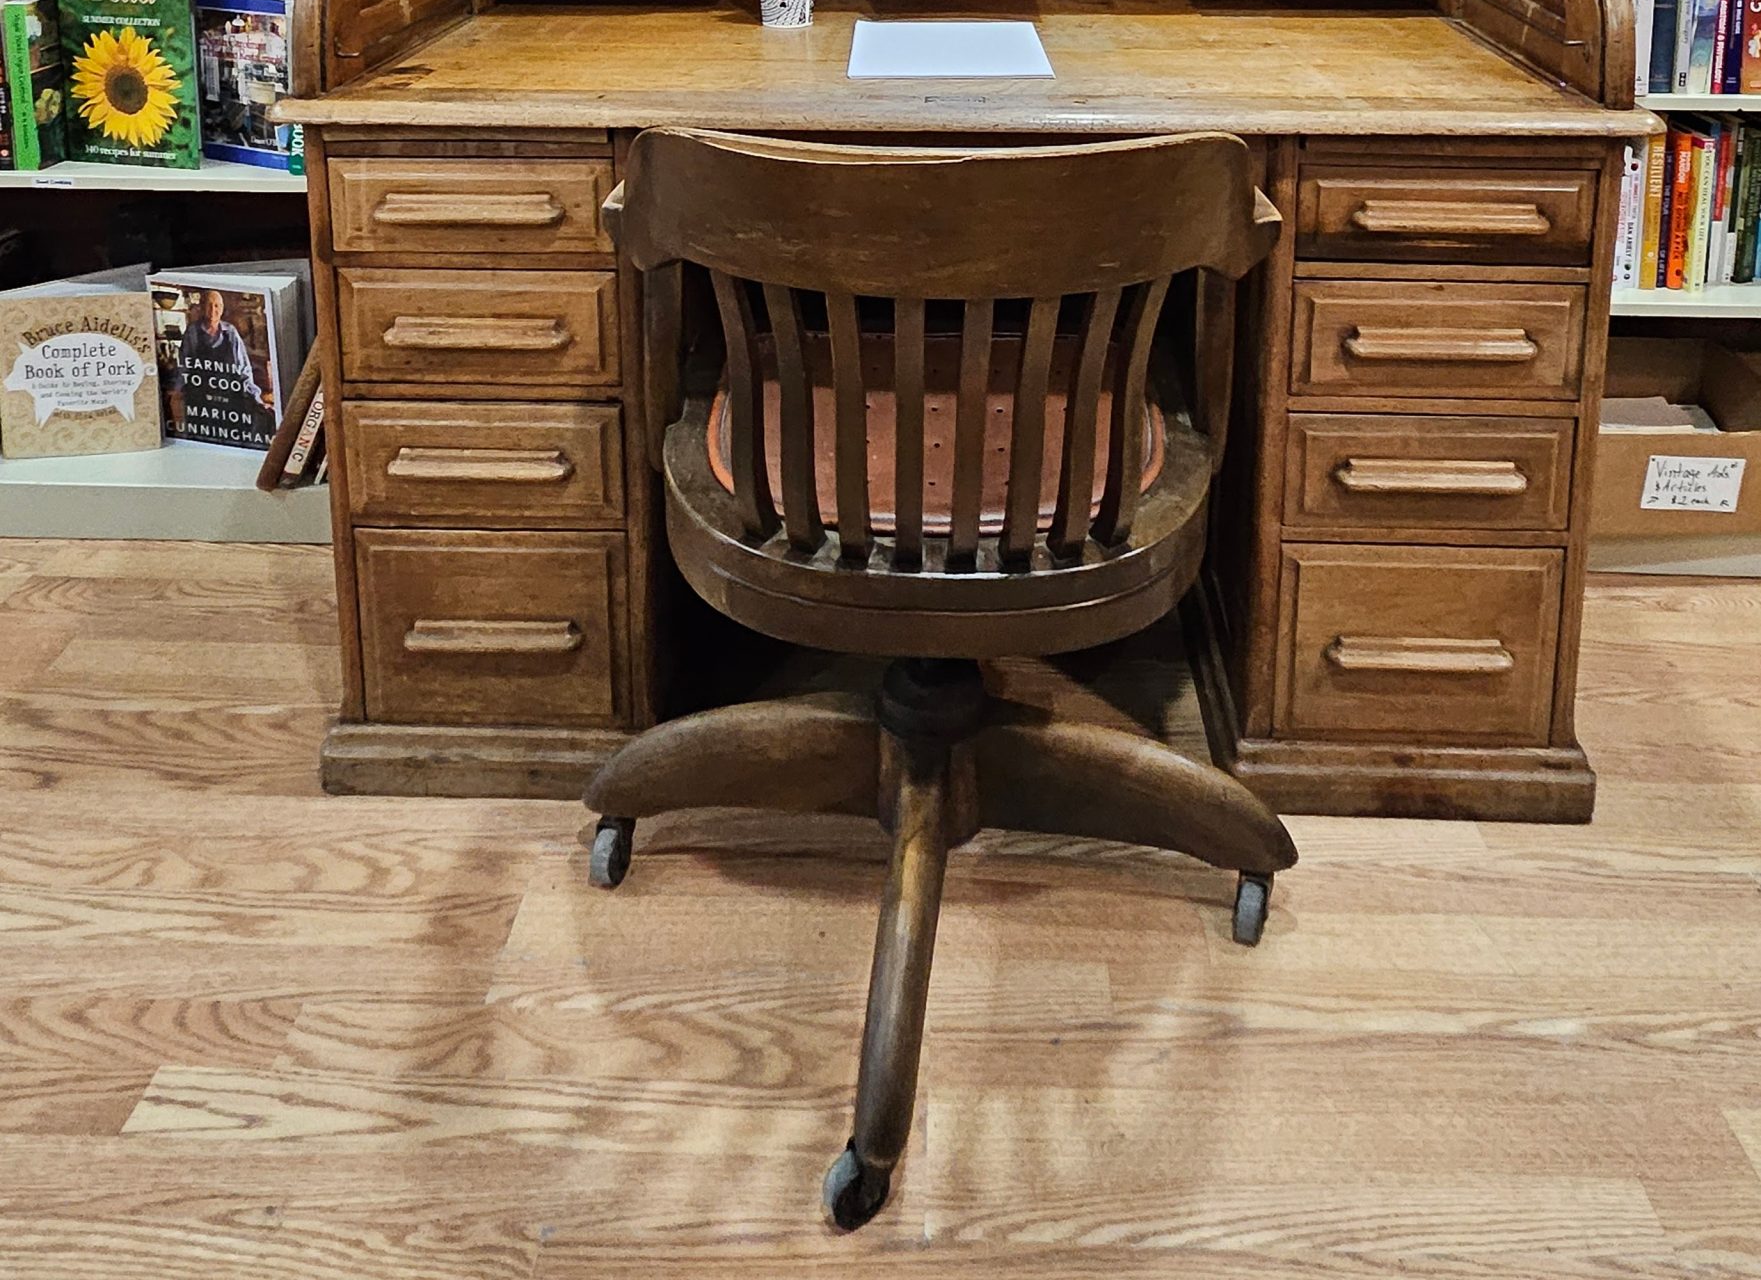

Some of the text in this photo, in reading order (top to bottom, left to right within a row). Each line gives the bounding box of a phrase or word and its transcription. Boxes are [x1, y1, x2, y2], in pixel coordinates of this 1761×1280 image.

[82, 15, 161, 26] SUMMER COLLECTION
[85, 144, 176, 160] 140 recipes for summer
[1650, 146, 1665, 198] RESILIENT
[22, 316, 151, 353] Bruce Aidells's
[42, 342, 117, 362] Complete
[25, 360, 136, 379] Book of Pork
[182, 373, 252, 393] TO COOK
[55, 390, 82, 398] Cooking
[205, 394, 229, 402] WITH
[187, 406, 252, 424] MARION
[167, 421, 275, 444] CUNNINGHAM
[292, 401, 324, 463] ORGANIC
[1657, 460, 1701, 480] Vintage
[1663, 480, 1708, 493] Articles
